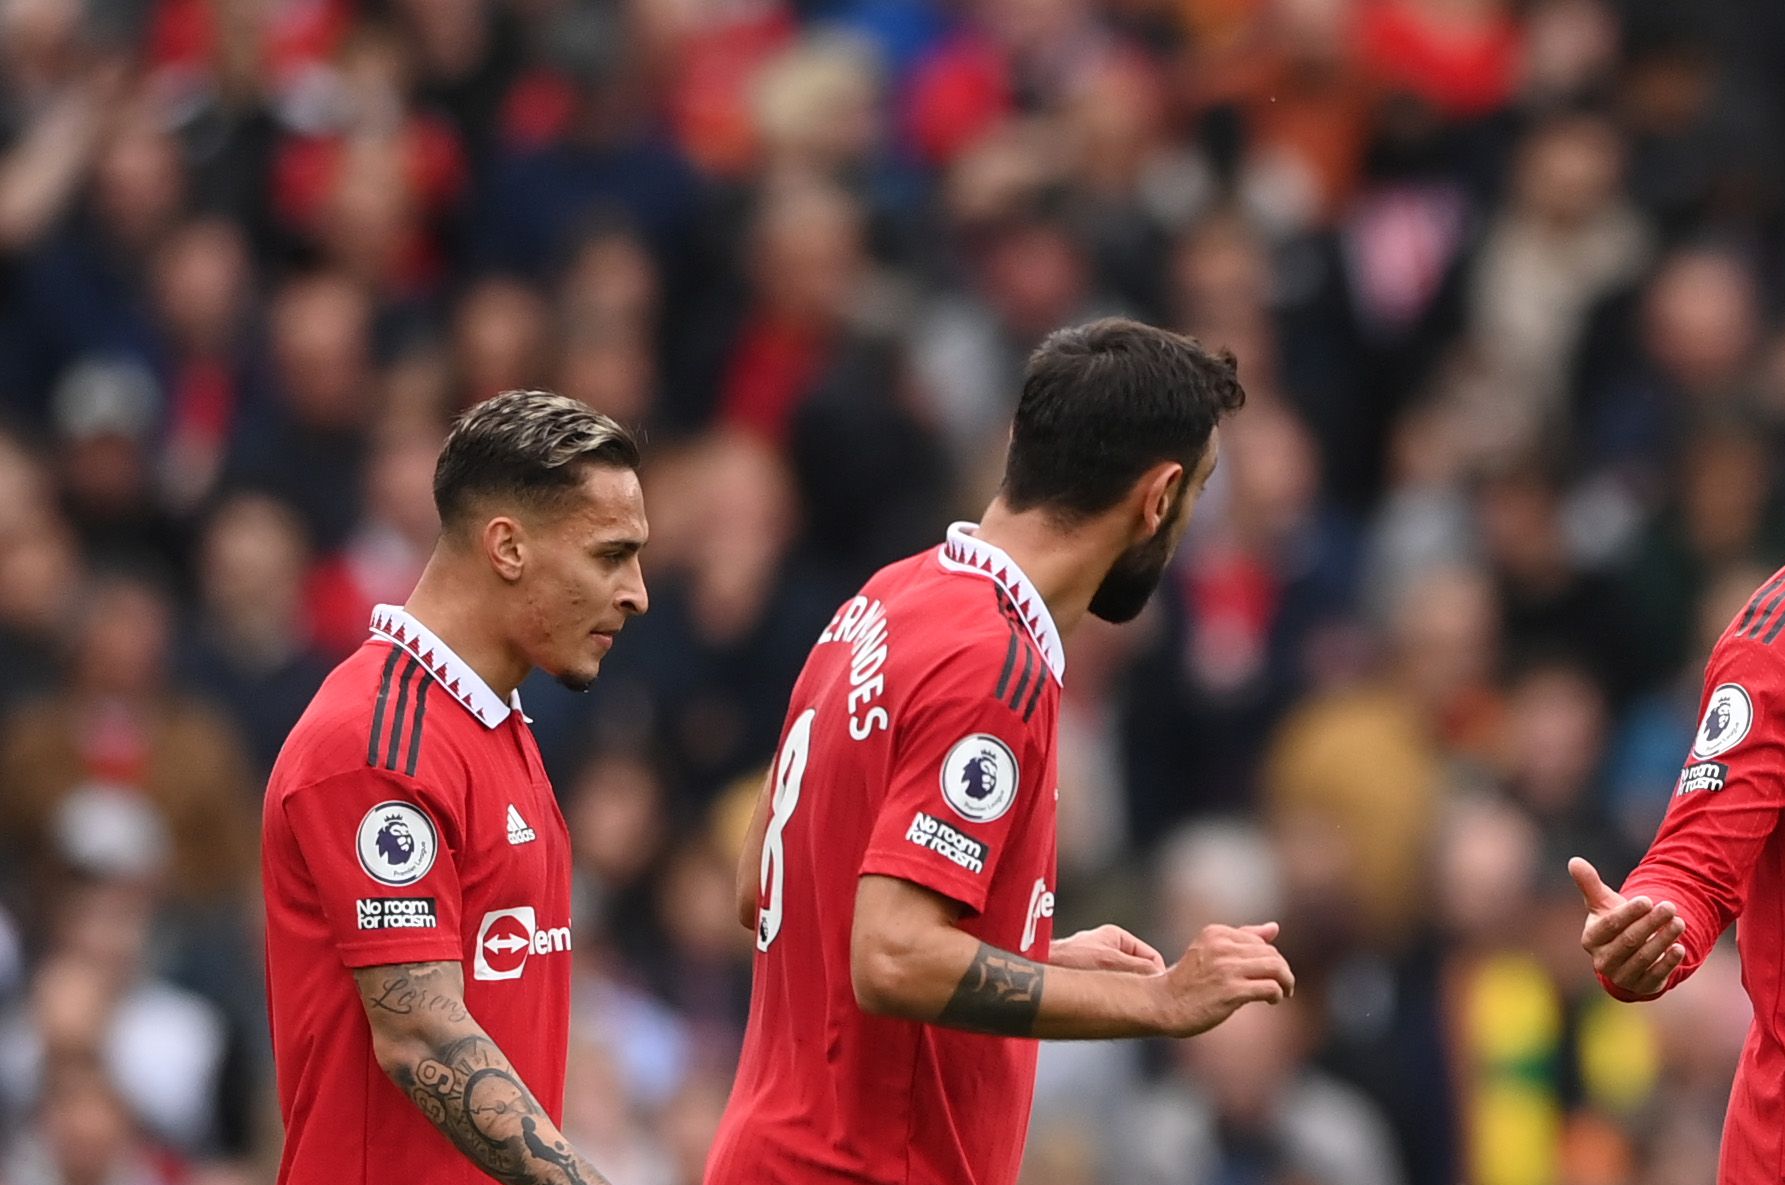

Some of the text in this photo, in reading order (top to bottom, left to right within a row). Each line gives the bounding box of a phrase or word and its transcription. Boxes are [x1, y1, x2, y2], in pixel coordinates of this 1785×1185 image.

[817, 595, 889, 742] ERNANDES
[757, 708, 816, 952] 8
[905, 824, 983, 875] for racism
[910, 811, 982, 858] No room
[356, 899, 430, 916] No room
[357, 913, 437, 930] for racism
